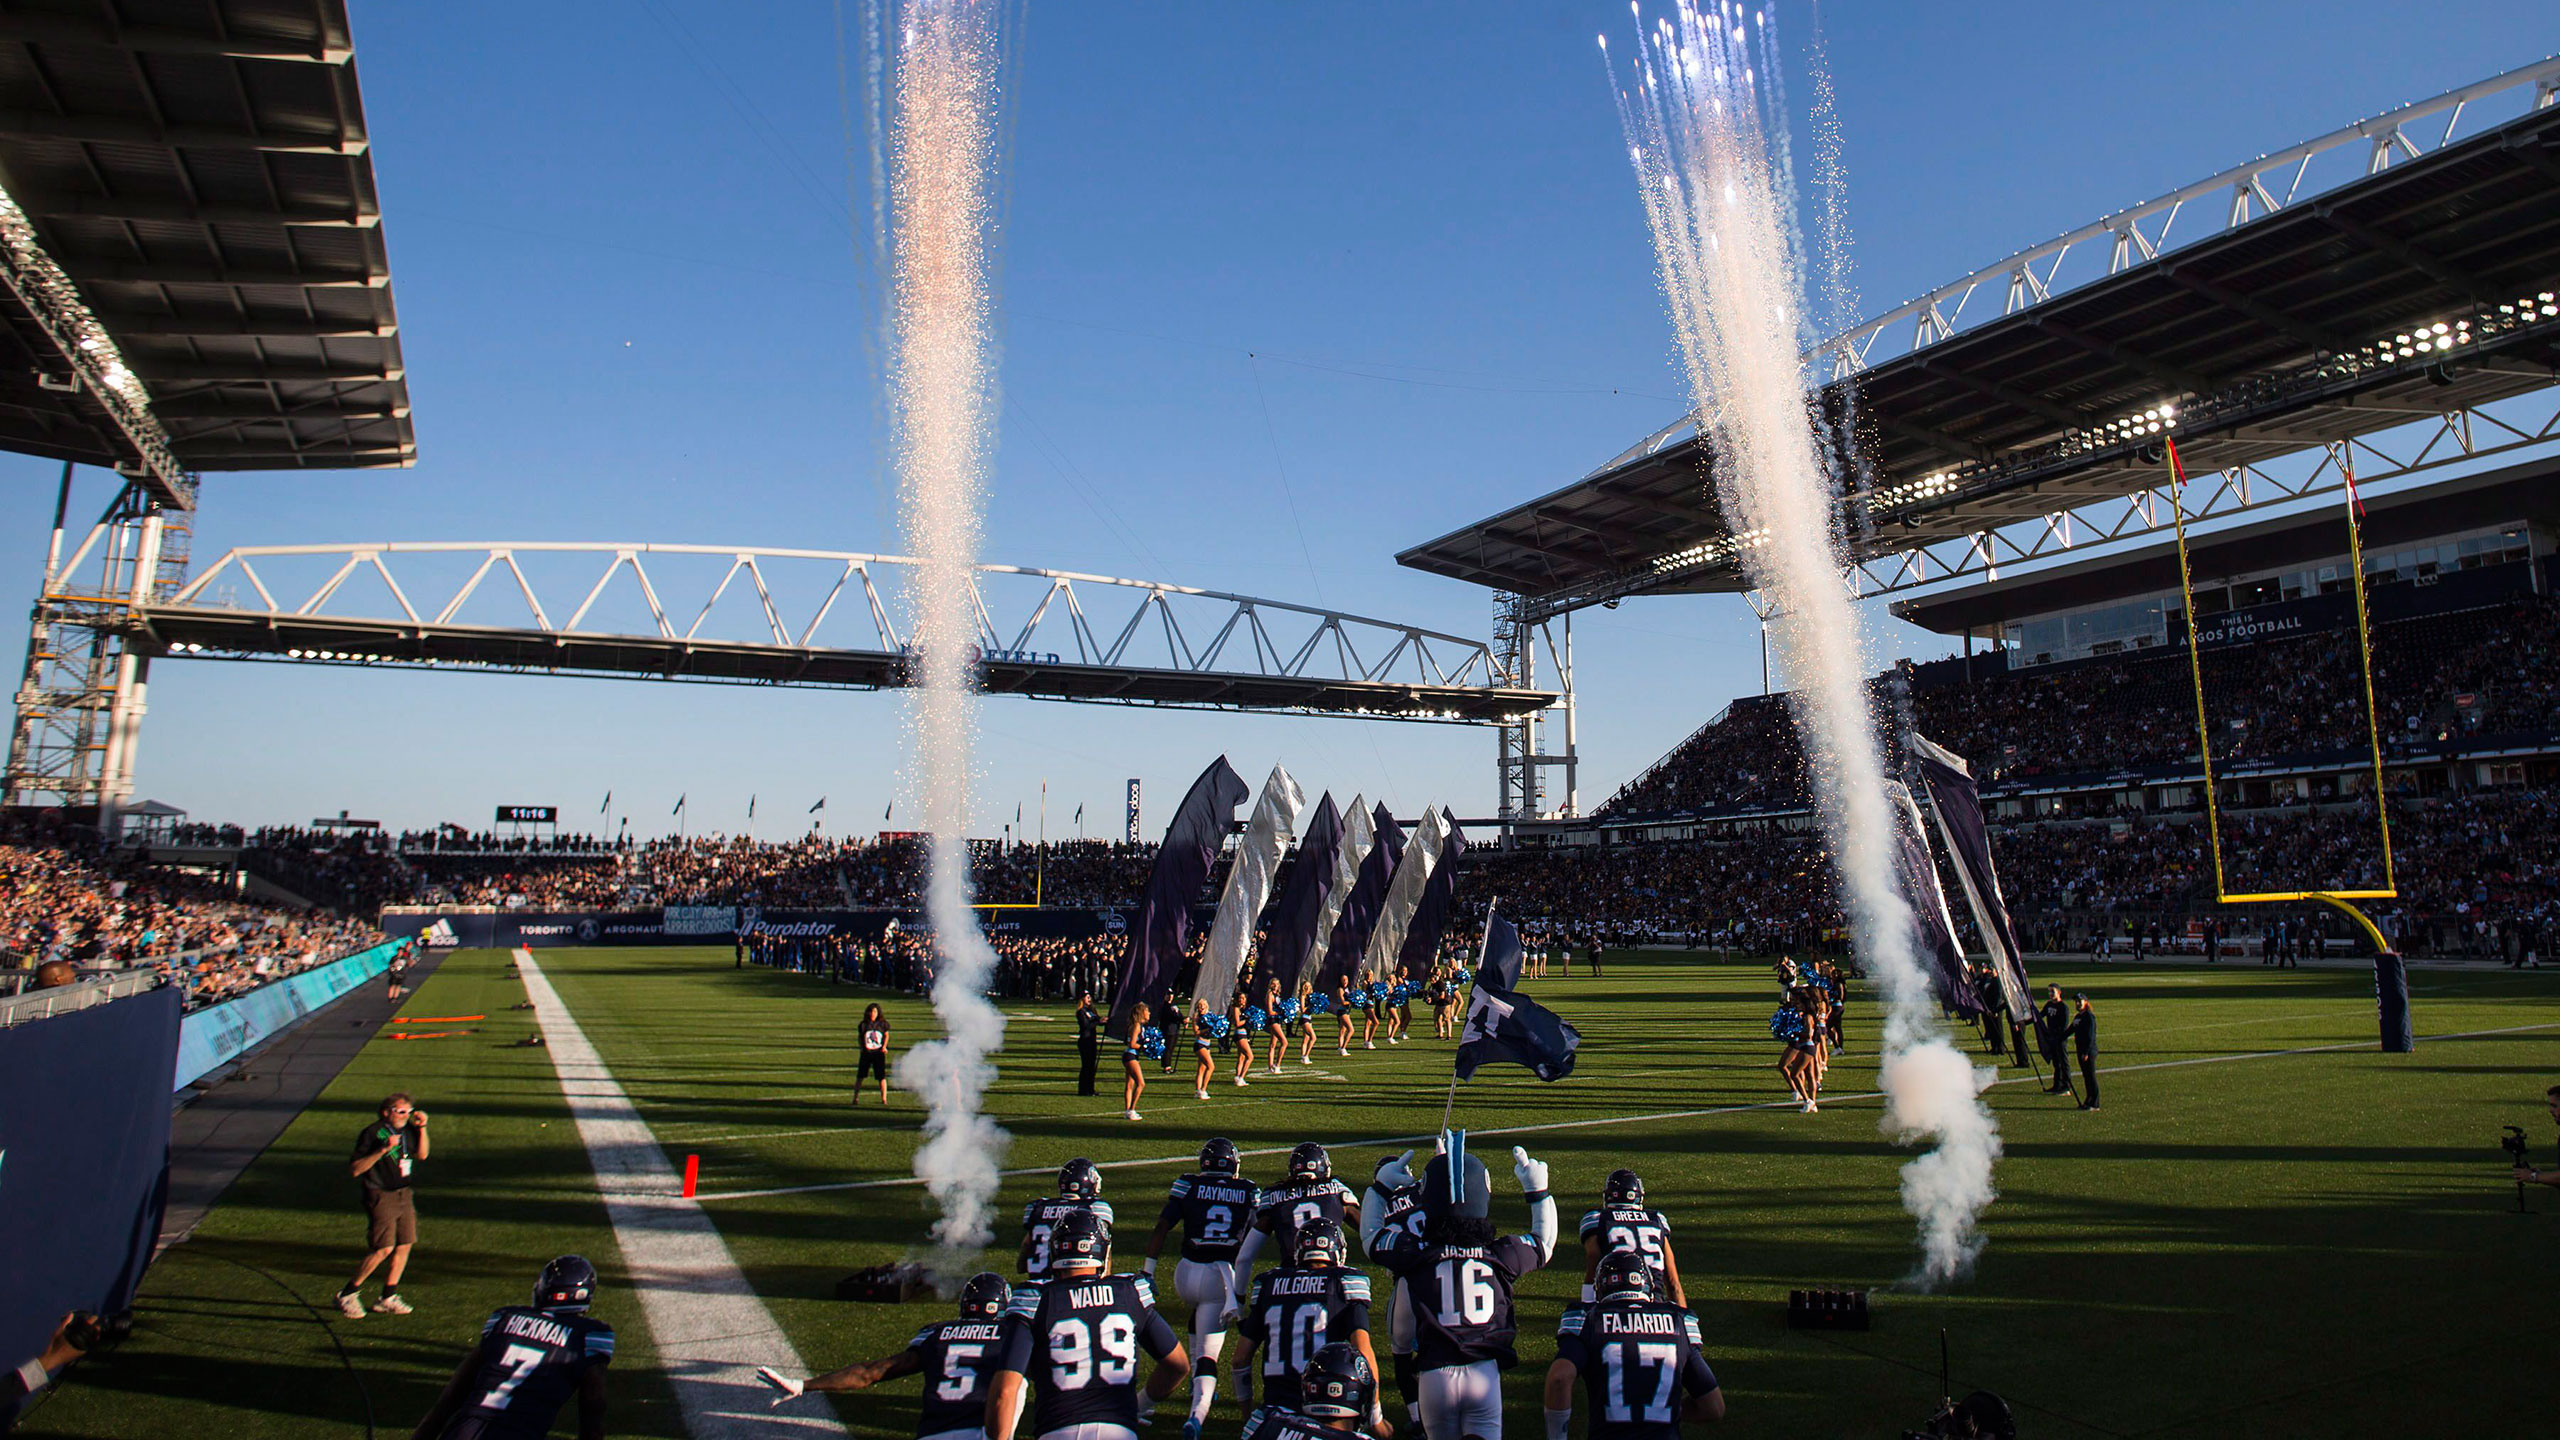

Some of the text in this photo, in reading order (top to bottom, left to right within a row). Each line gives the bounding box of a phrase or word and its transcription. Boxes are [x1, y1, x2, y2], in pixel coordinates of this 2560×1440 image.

[2179, 616, 2302, 647] AGOS FOOTBALL
[2221, 614, 2253, 627] THIS IS
[987, 649, 1061, 665] FIELD
[511, 808, 547, 819] 11:16
[519, 925, 573, 935] TORONTO
[604, 925, 663, 934] ARGONAUT
[753, 921, 836, 937] Purolator
[1108, 921, 1125, 929] SUN
[1197, 1185, 1246, 1204] RAYMOND
[1384, 1194, 1415, 1218] LACK
[1203, 1204, 1233, 1239] 2
[1612, 1211, 1650, 1221] GREEN
[1027, 1224, 1052, 1273] 3
[1607, 1225, 1665, 1271] 25
[1068, 1285, 1115, 1309] WAUD
[1272, 1276, 1328, 1295] KILGORE
[1435, 1258, 1494, 1327] 16
[504, 1314, 573, 1347] HICKMAN
[939, 1324, 1001, 1340] GABRIEL
[1602, 1313, 1675, 1334] FAJARDO
[1264, 1302, 1328, 1376] 10
[1049, 1313, 1137, 1391] 99
[480, 1342, 547, 1410] 7
[936, 1343, 986, 1401] 5
[1601, 1342, 1677, 1424] 17
